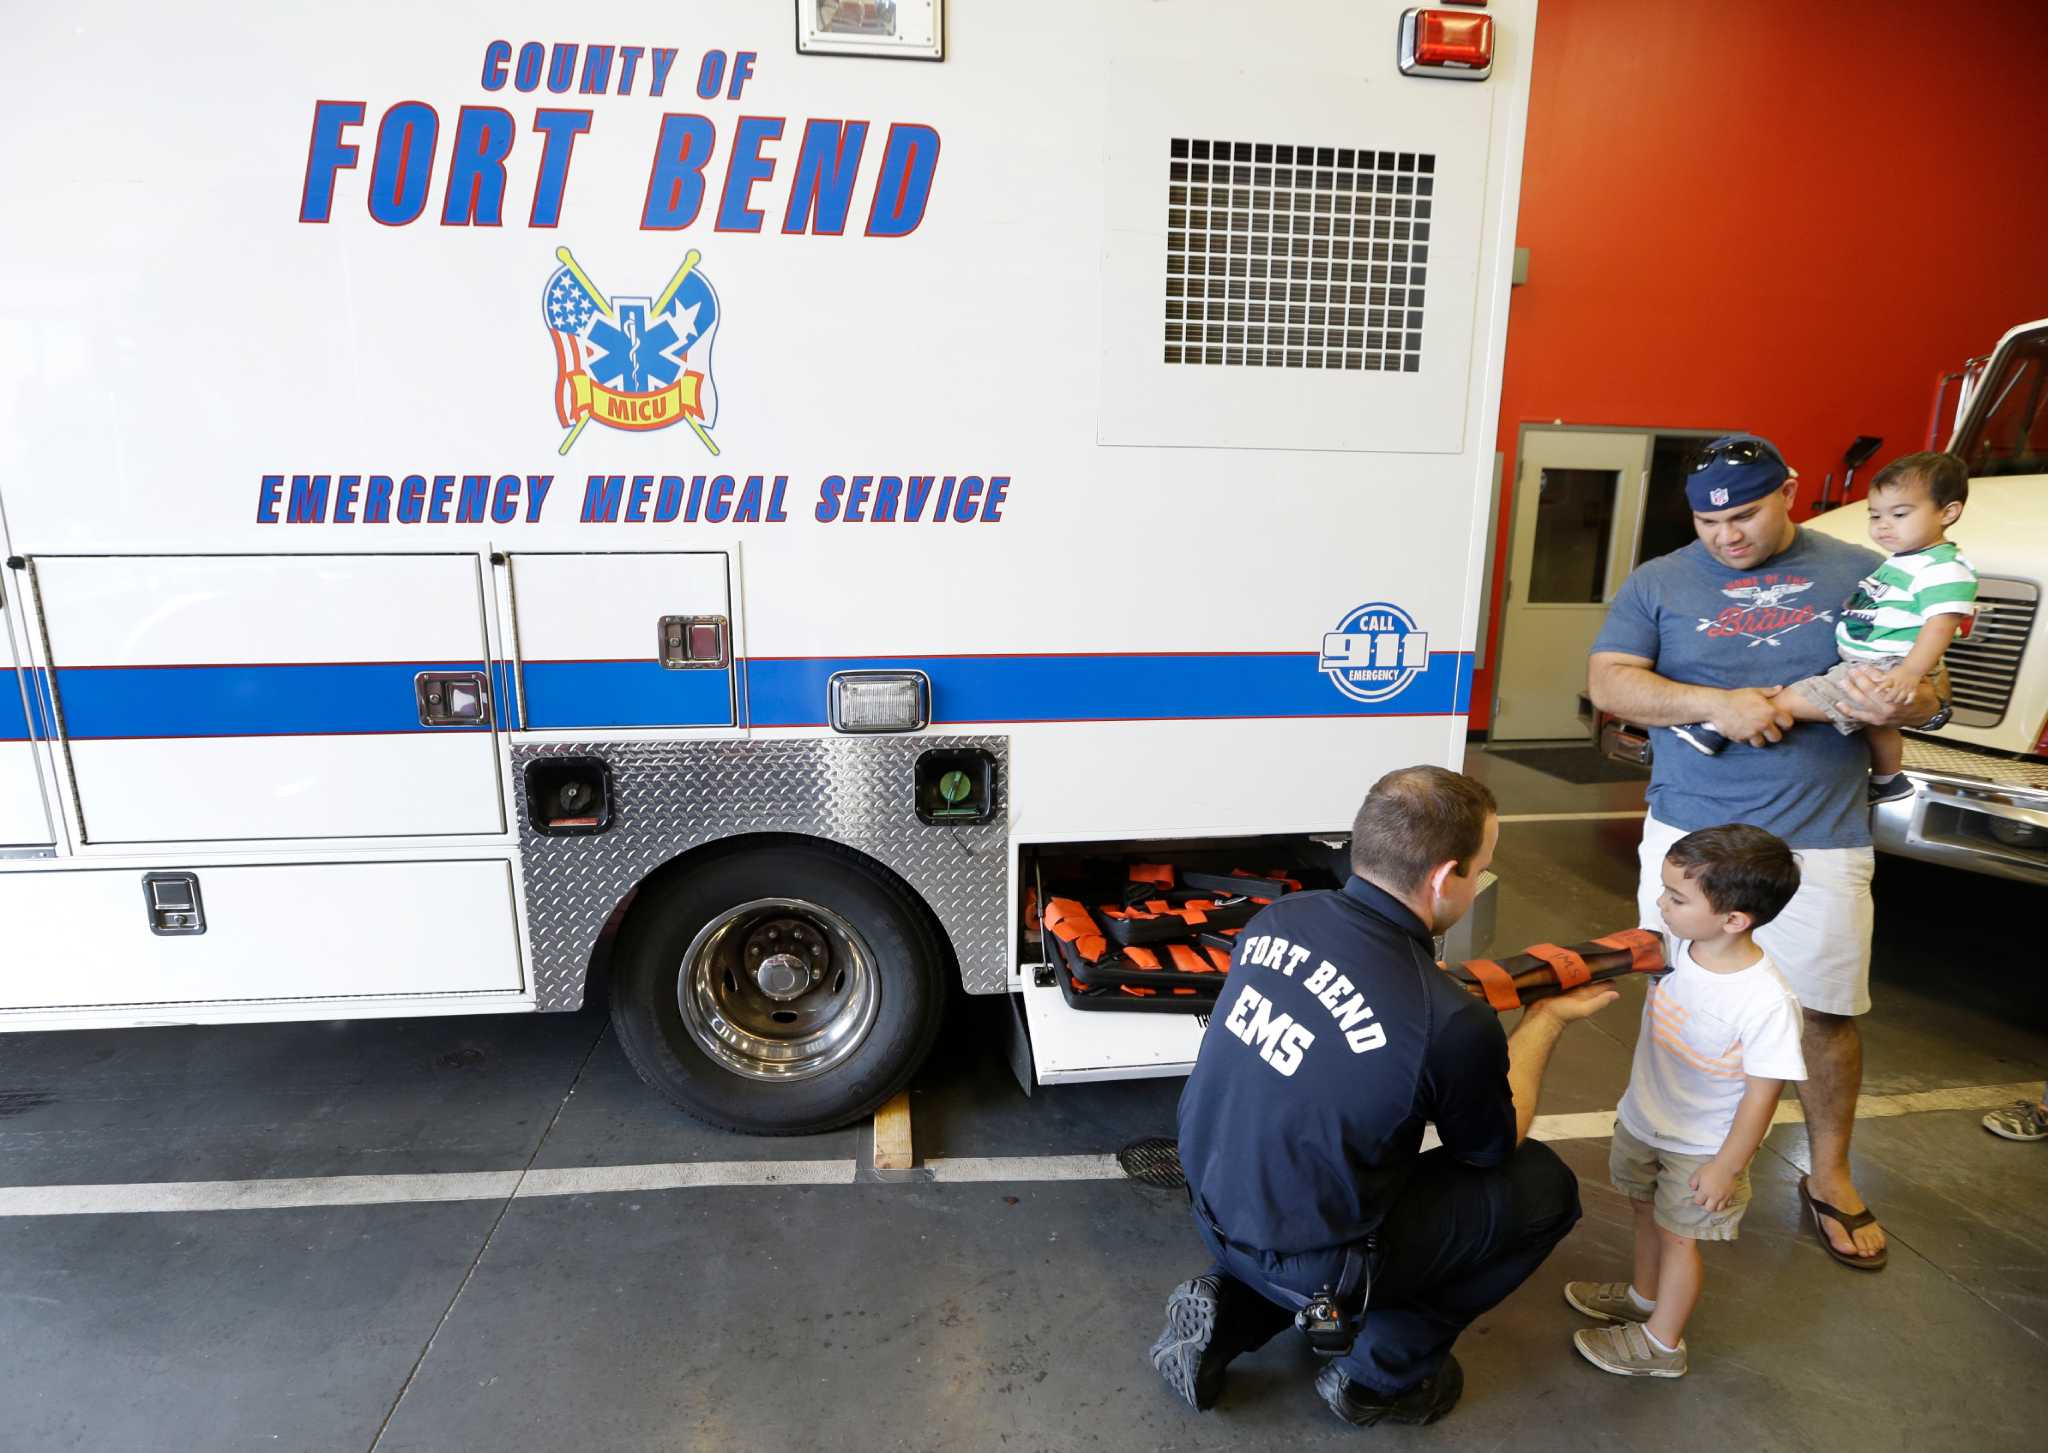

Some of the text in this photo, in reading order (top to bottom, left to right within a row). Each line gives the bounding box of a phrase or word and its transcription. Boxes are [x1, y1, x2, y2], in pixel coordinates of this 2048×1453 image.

[481, 40, 757, 100] COUNTY OF
[299, 100, 941, 238] FORT BEND
[607, 396, 667, 422] MICU
[256, 475, 1011, 524] EMERGENCY MEDICAL SERVICE
[1359, 615, 1394, 631] CALL
[1349, 670, 1399, 681] EMERGENCY
[1240, 936, 1387, 1053] FORT BEND
[1225, 984, 1316, 1077] EMS
